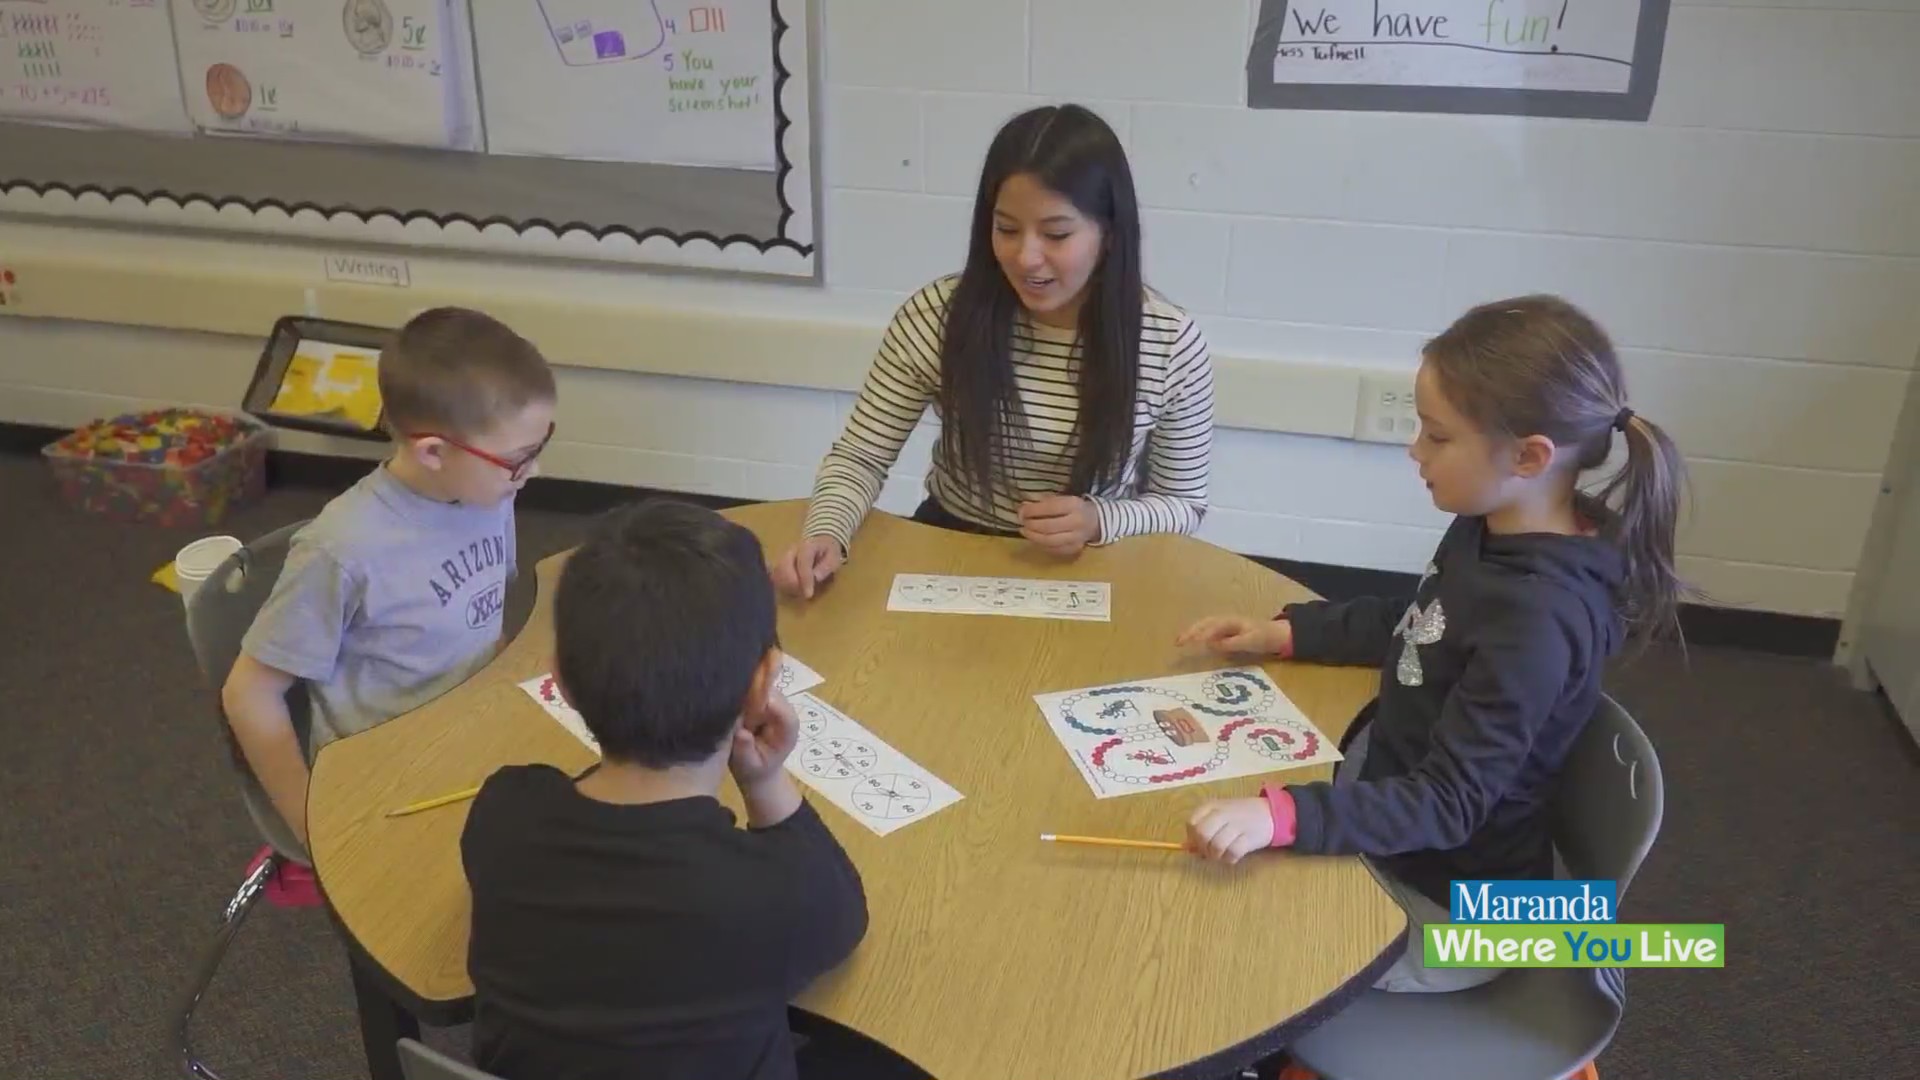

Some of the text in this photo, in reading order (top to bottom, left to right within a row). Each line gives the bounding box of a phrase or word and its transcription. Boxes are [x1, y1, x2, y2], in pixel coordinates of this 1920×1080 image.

[665, 20, 675, 33] 4
[1292, 0, 1568, 50] We have fun!
[663, 49, 713, 71] 5 You
[669, 76, 759, 95] have your
[333, 258, 400, 286] Writing
